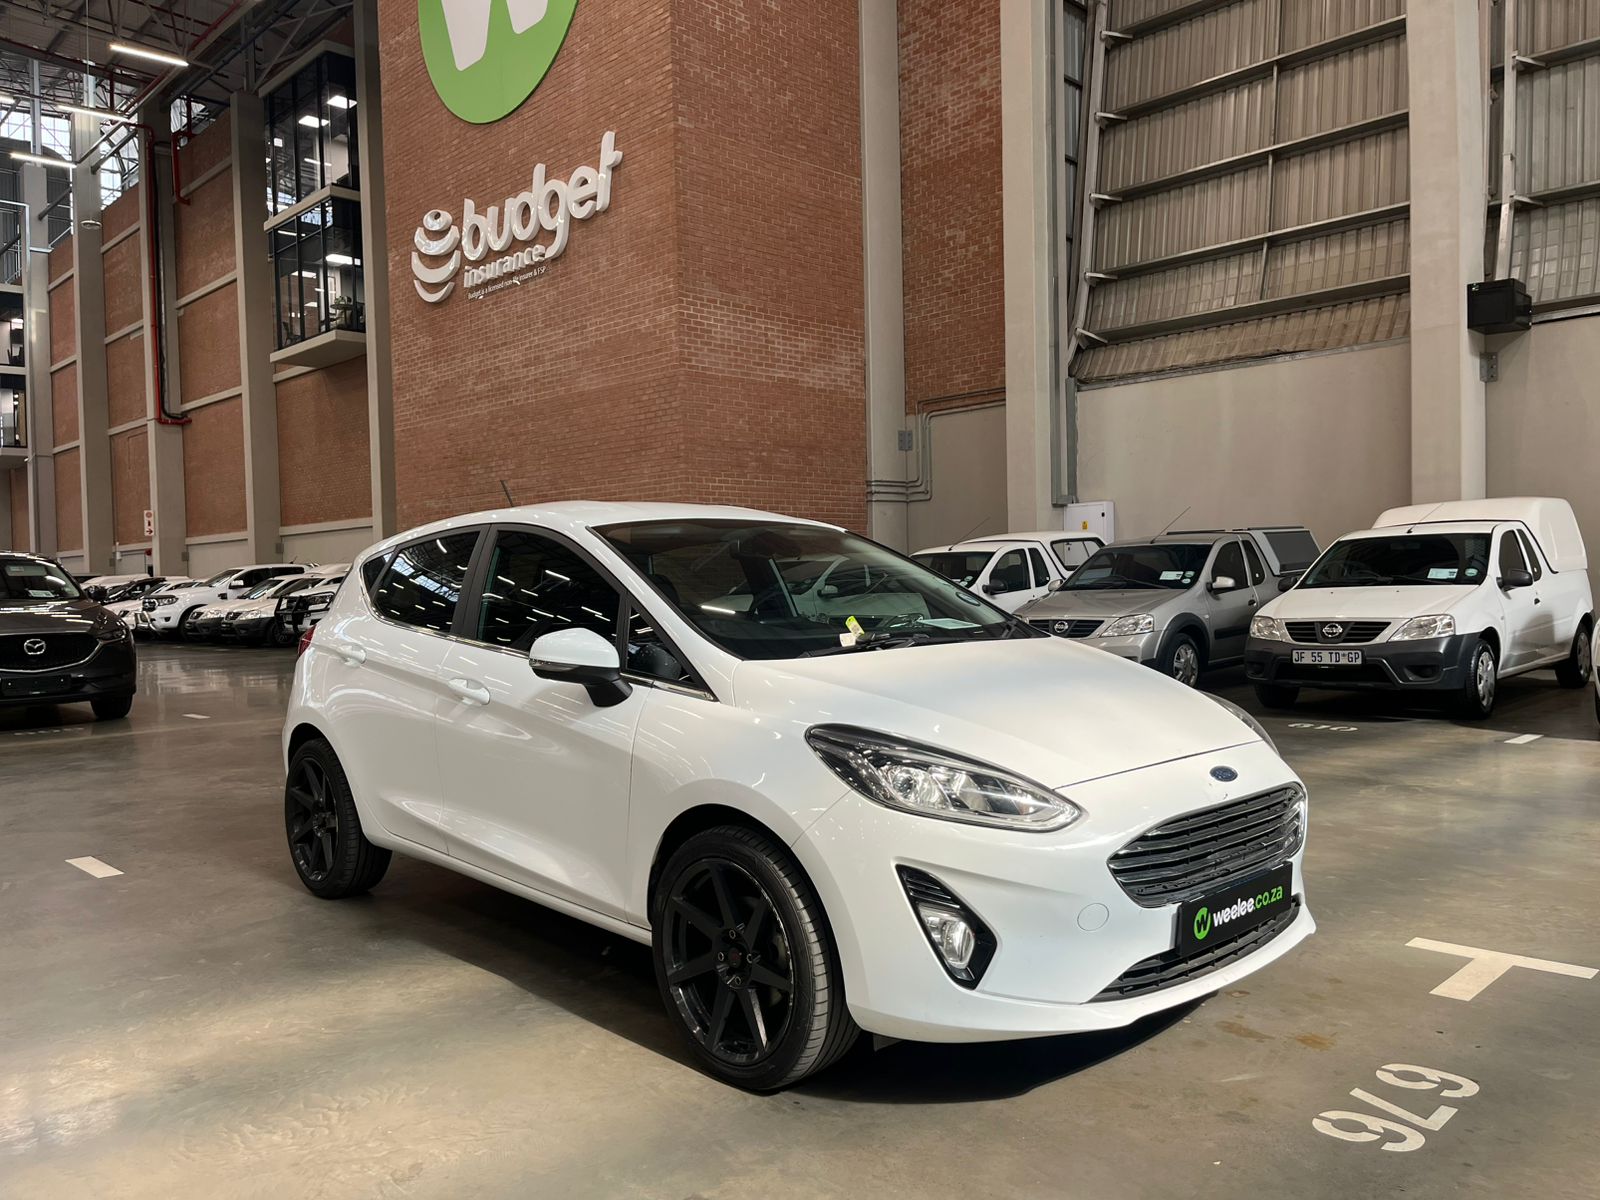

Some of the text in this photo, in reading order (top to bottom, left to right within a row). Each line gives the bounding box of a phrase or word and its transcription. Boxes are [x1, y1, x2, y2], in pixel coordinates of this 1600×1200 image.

[461, 130, 624, 261] budget
[464, 244, 546, 288] insurance
[488, 281, 504, 291] licensed
[519, 271, 533, 280] insurer
[538, 265, 546, 274] FSP
[1294, 652, 1359, 662] JF 55 TD GP
[1213, 886, 1283, 927] weelee.co.za
